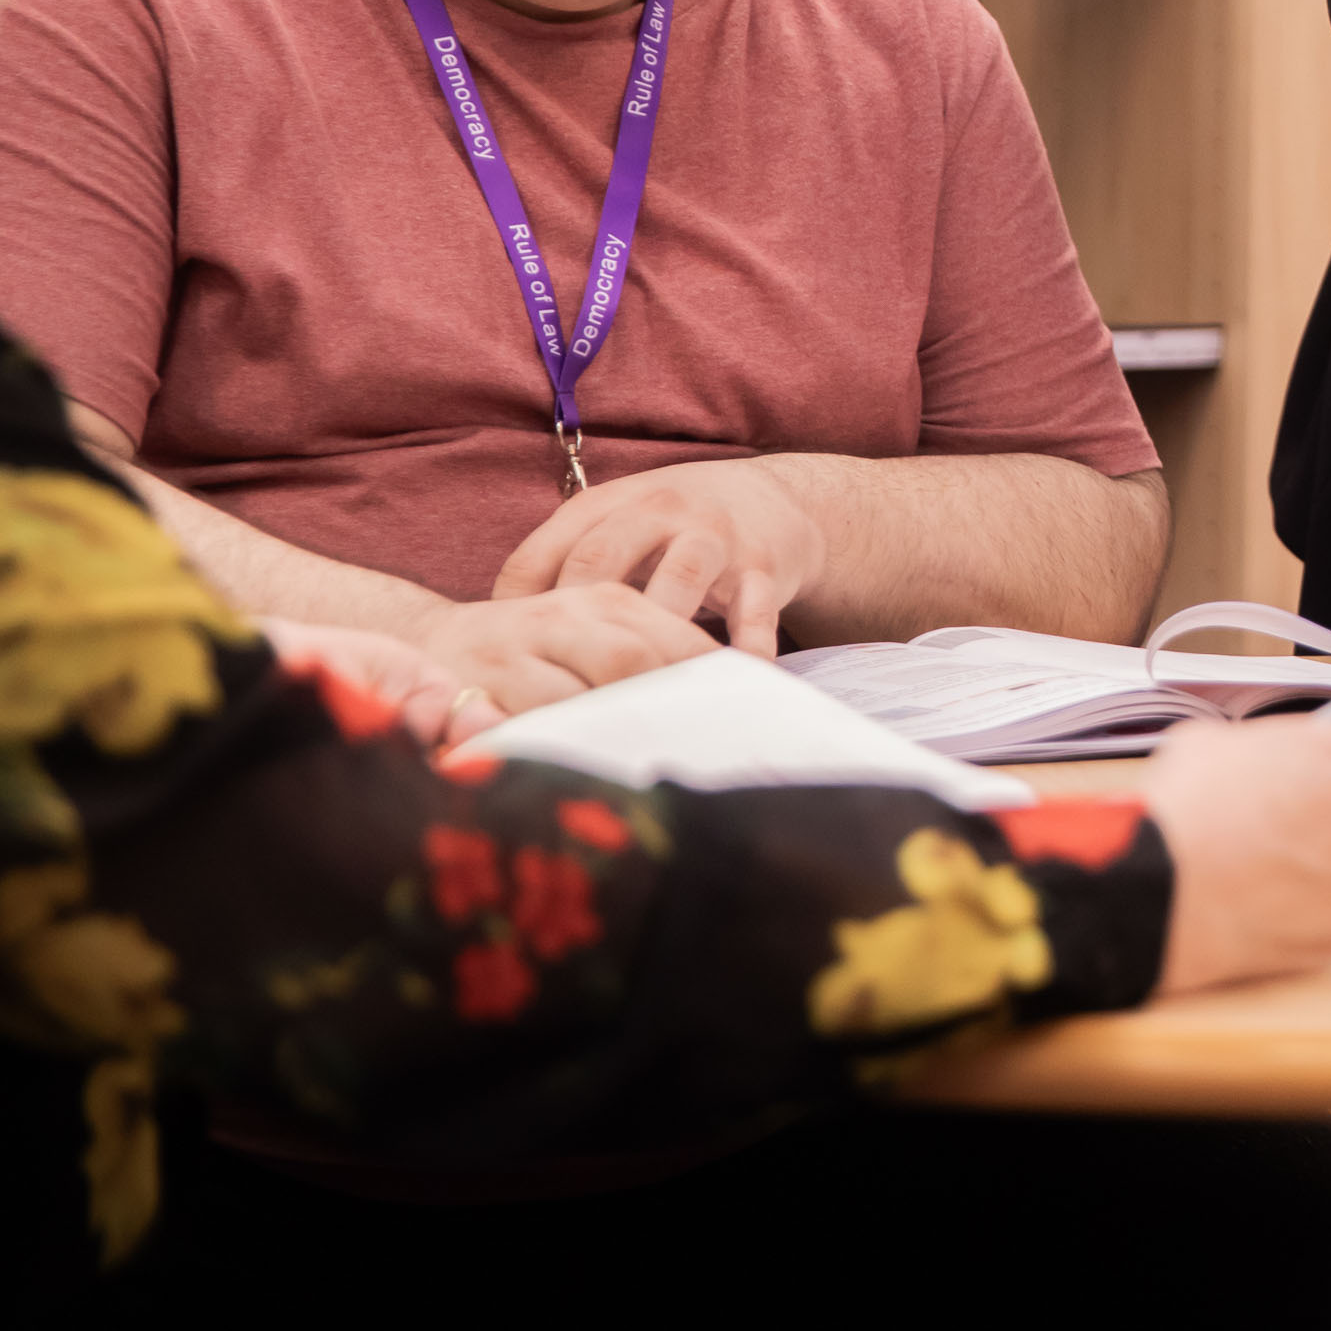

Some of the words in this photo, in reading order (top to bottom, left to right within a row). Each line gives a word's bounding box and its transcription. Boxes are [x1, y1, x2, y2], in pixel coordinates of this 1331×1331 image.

[643, 0, 666, 43] Law
[641, 41, 660, 66] of
[433, 35, 496, 160] Democracy
[626, 69, 657, 117] Rule
[508, 223, 540, 275] Rule
[530, 280, 553, 303] of
[572, 233, 627, 358] Democracy
[538, 308, 562, 356] Law
